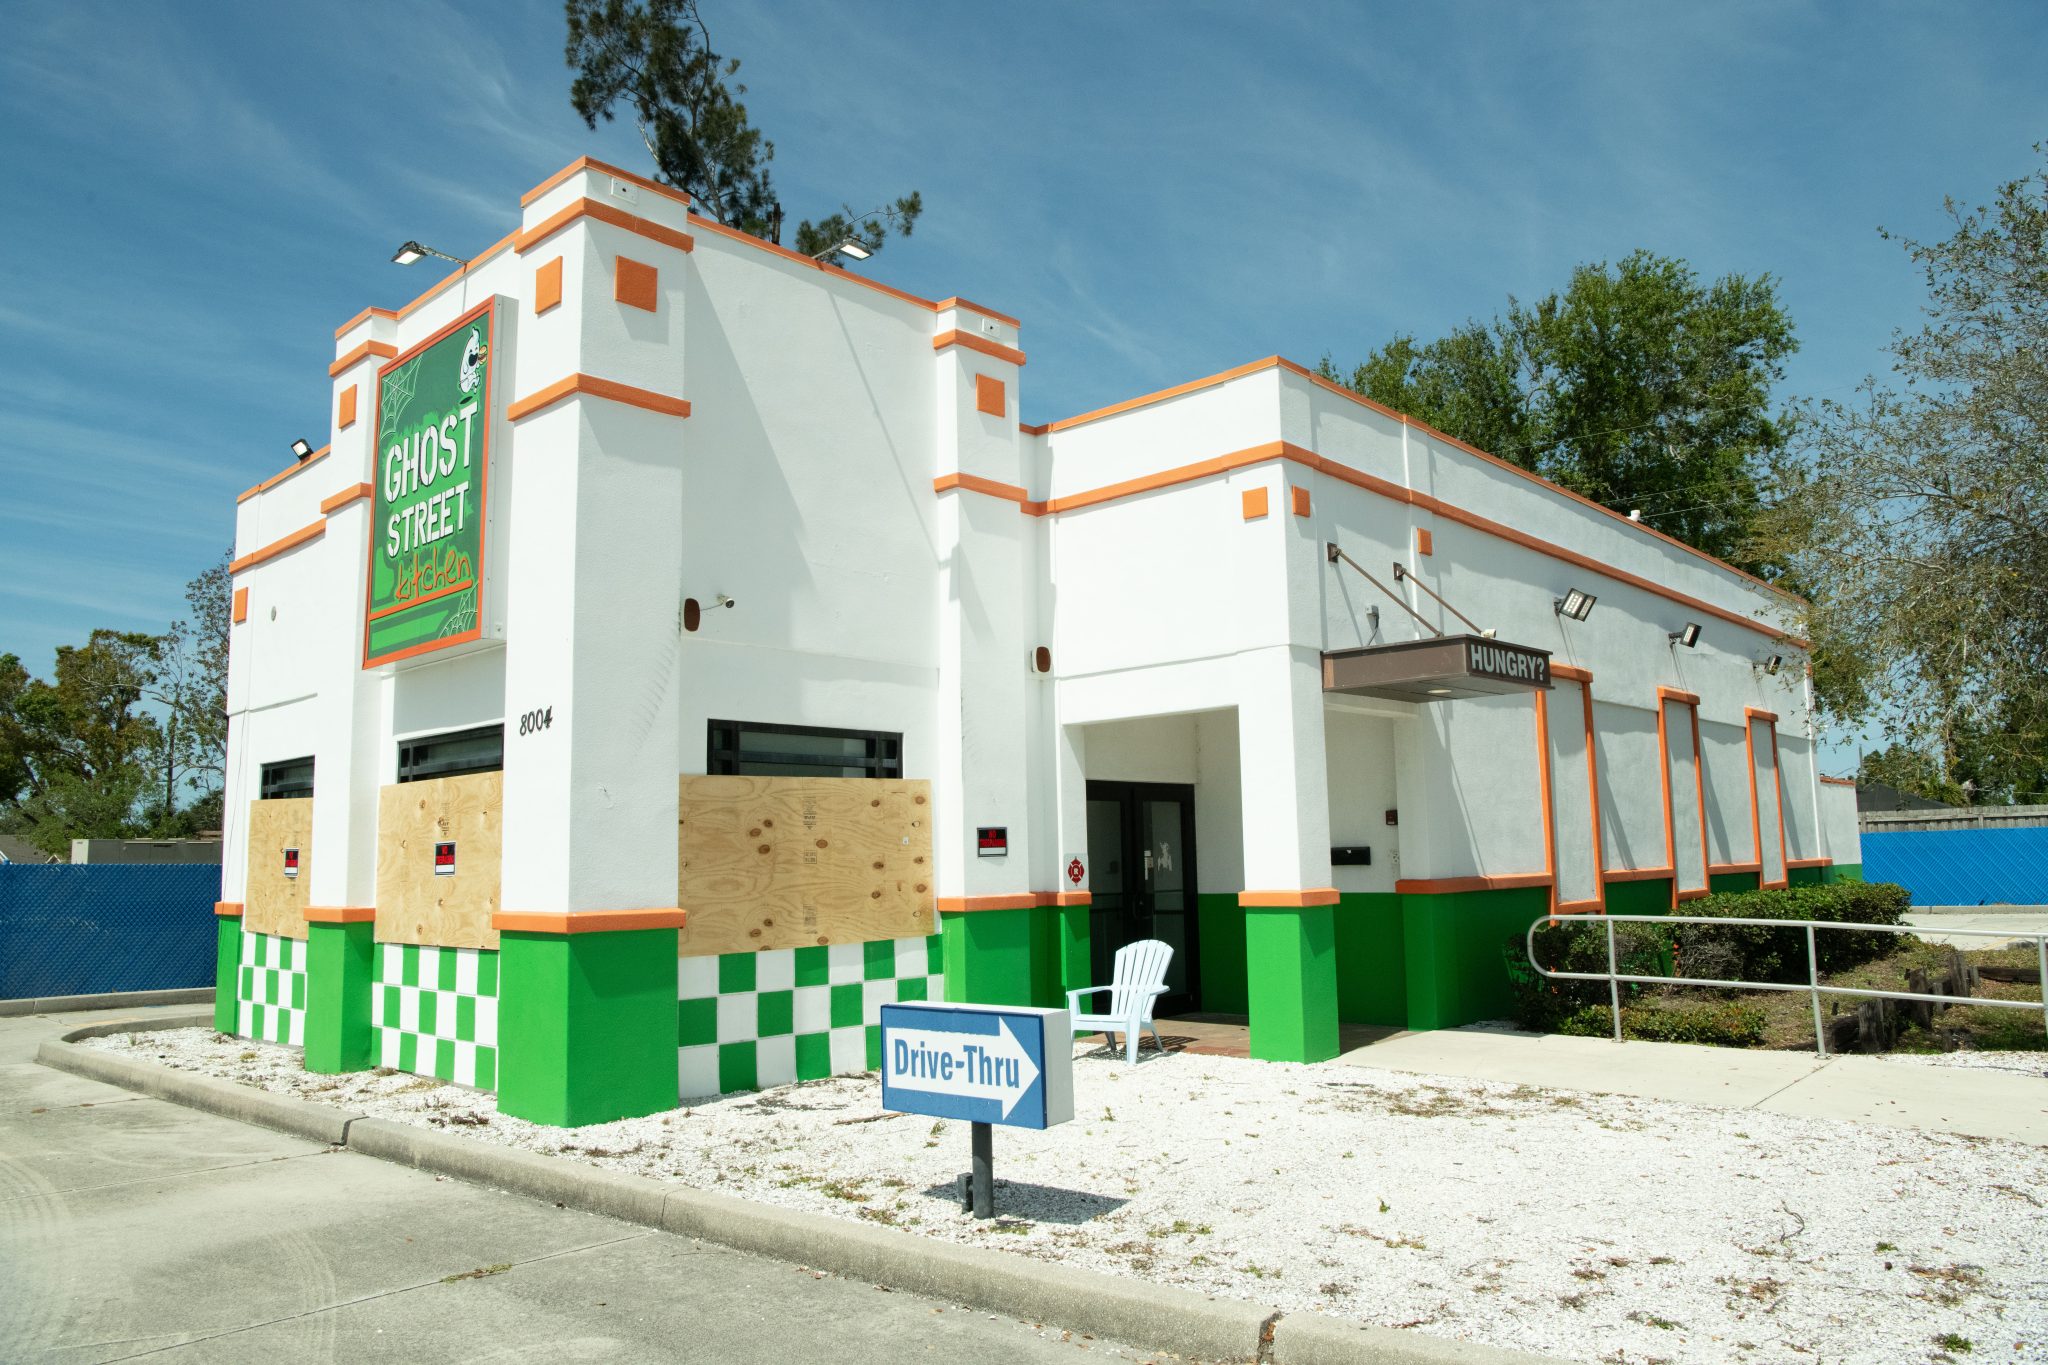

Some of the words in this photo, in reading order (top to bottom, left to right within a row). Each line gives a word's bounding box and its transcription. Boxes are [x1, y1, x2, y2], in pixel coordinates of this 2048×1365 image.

[384, 401, 477, 503] GHOST
[387, 480, 469, 558] STREET
[396, 545, 471, 599] kitchen
[1470, 644, 1545, 681] HUNGRY?
[519, 705, 553, 736] 8004
[894, 1038, 1020, 1089] Drive-Thru
